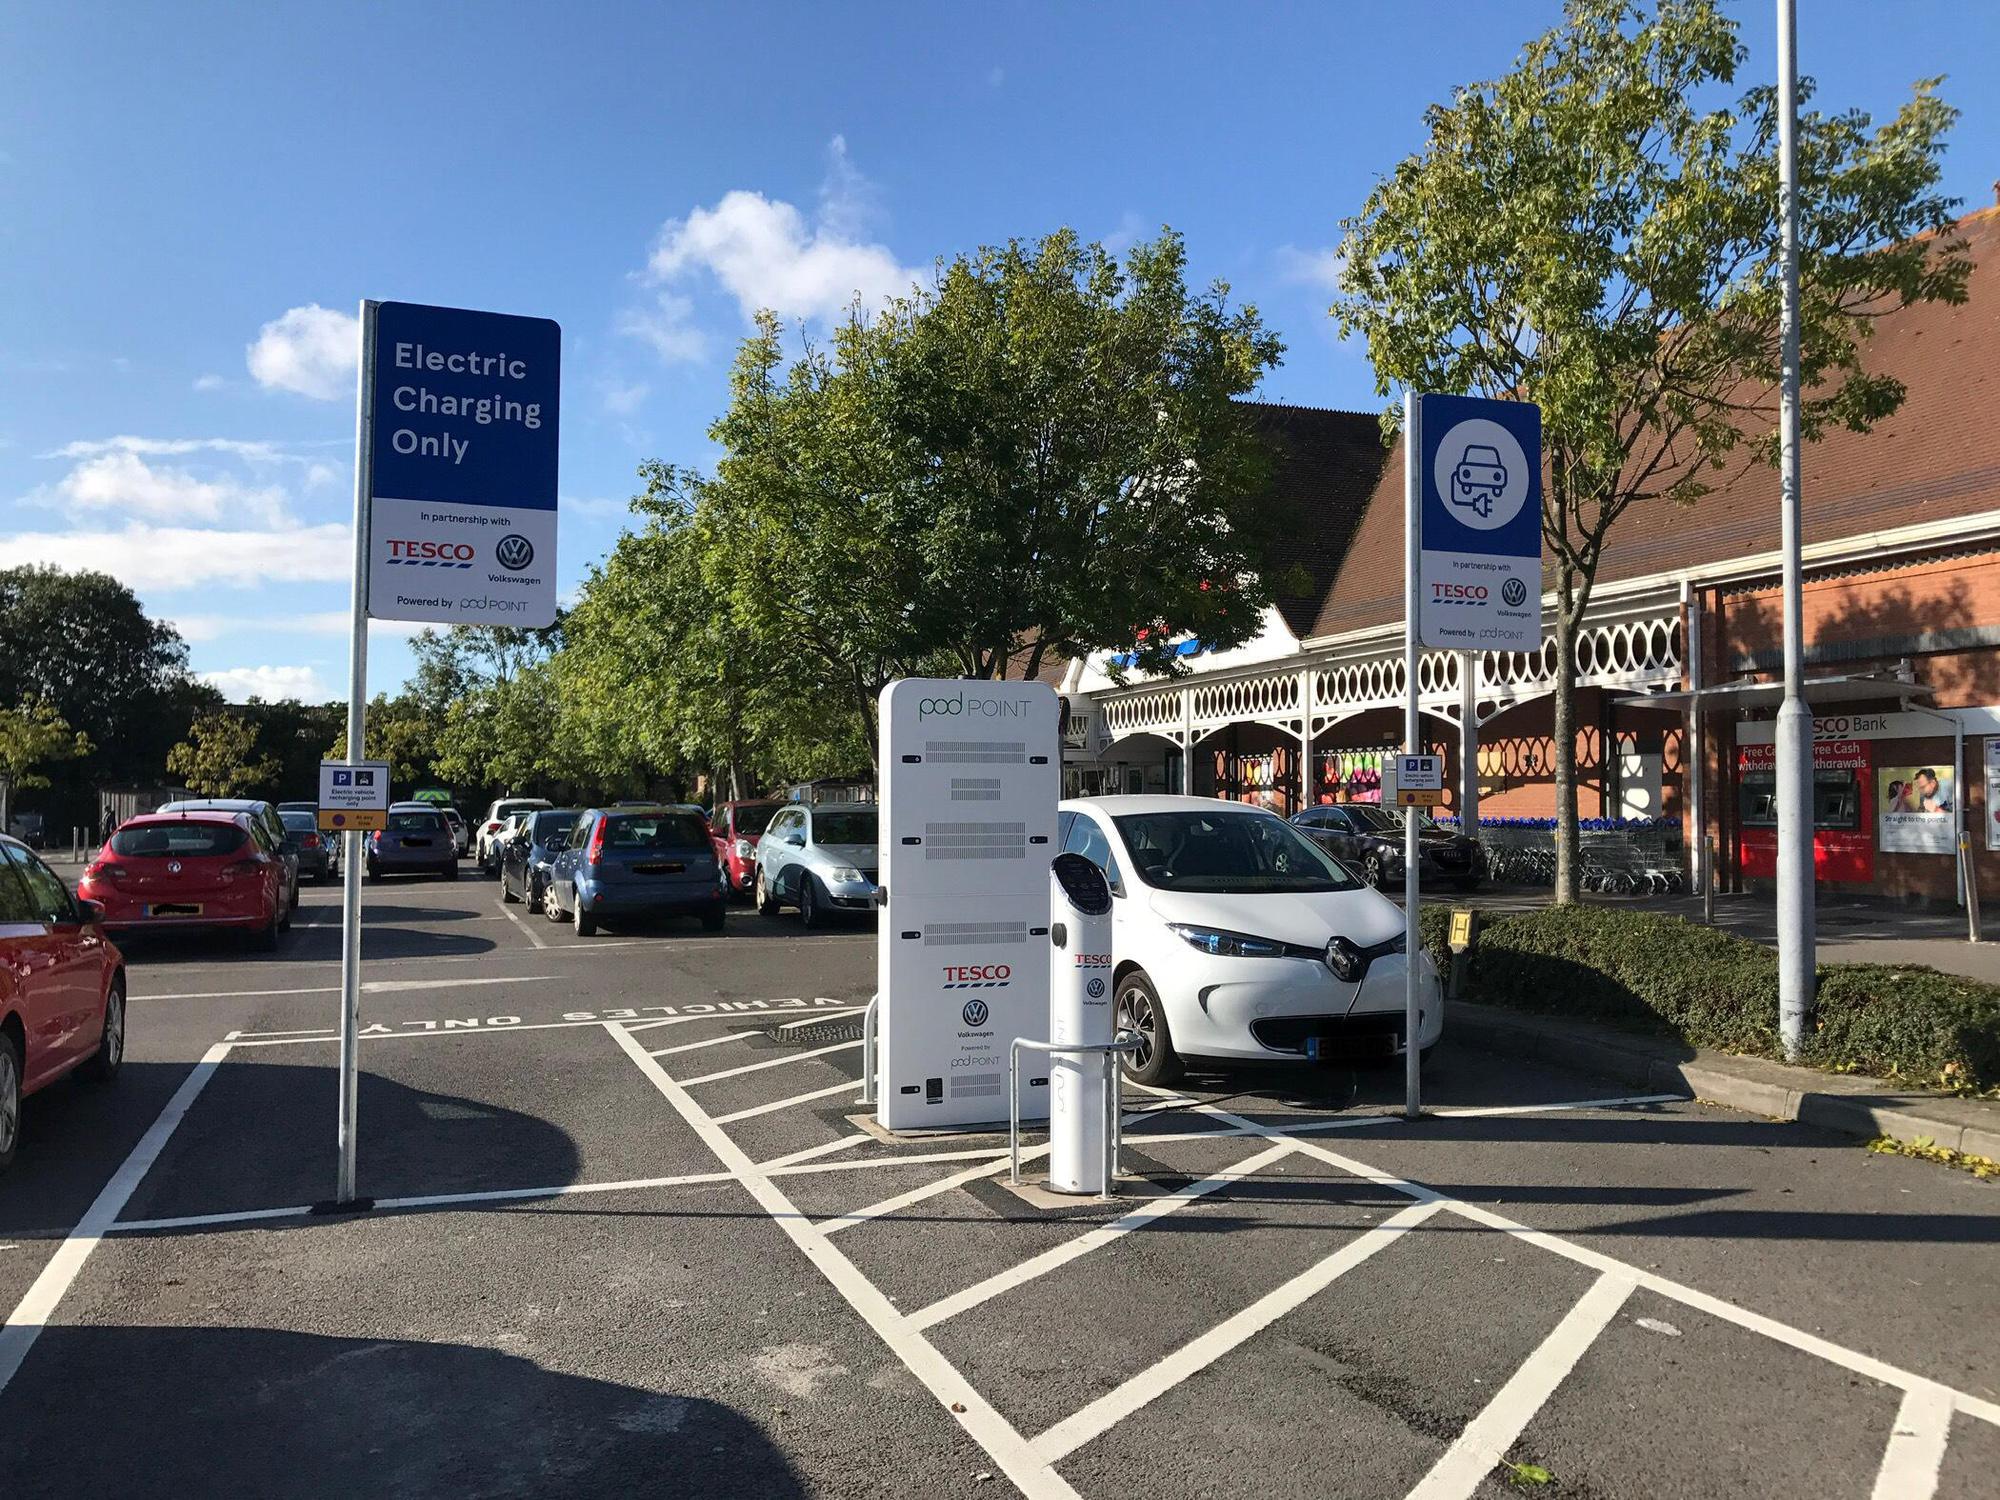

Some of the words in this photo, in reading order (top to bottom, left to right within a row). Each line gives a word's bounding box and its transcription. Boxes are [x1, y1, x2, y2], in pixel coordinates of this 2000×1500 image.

[395, 342, 527, 379] Electric
[393, 386, 541, 429] Charging
[392, 428, 469, 465] Only
[420, 511, 430, 521] In
[431, 513, 489, 526] partnership
[490, 516, 511, 526] with
[386, 539, 475, 561] TESCO
[1452, 560, 1460, 568] In
[1460, 561, 1497, 571] partnership
[487, 574, 541, 586] Volkswagen
[1431, 583, 1488, 599] TESCO
[396, 595, 441, 607] Powered
[441, 597, 453, 609] by
[459, 595, 487, 611] pod
[489, 600, 529, 612] POINT
[1496, 609, 1532, 619] Volkswagen
[1440, 627, 1468, 637] Powered
[1468, 629, 1476, 638] by
[1498, 631, 1525, 640] POINT
[919, 690, 963, 722] pod
[967, 699, 1032, 717] POINT
[1812, 718, 1850, 734] SCO
[1853, 716, 1888, 732] Bank
[1743, 746, 1763, 758] Free
[1764, 745, 1777, 757] Ca
[1812, 744, 1832, 755] ree
[1833, 742, 1860, 755] Cash
[1812, 756, 1867, 770] ithdrawals
[338, 773, 347, 783] P
[1074, 954, 1112, 964] TESCO
[943, 964, 1011, 982] TESCO
[562, 997, 845, 1021] VEHICLES
[358, 1015, 521, 1034] ONLY
[957, 1031, 995, 1039] Volkswagen
[950, 1055, 971, 1069] pod
[971, 1056, 1001, 1065] POINT
